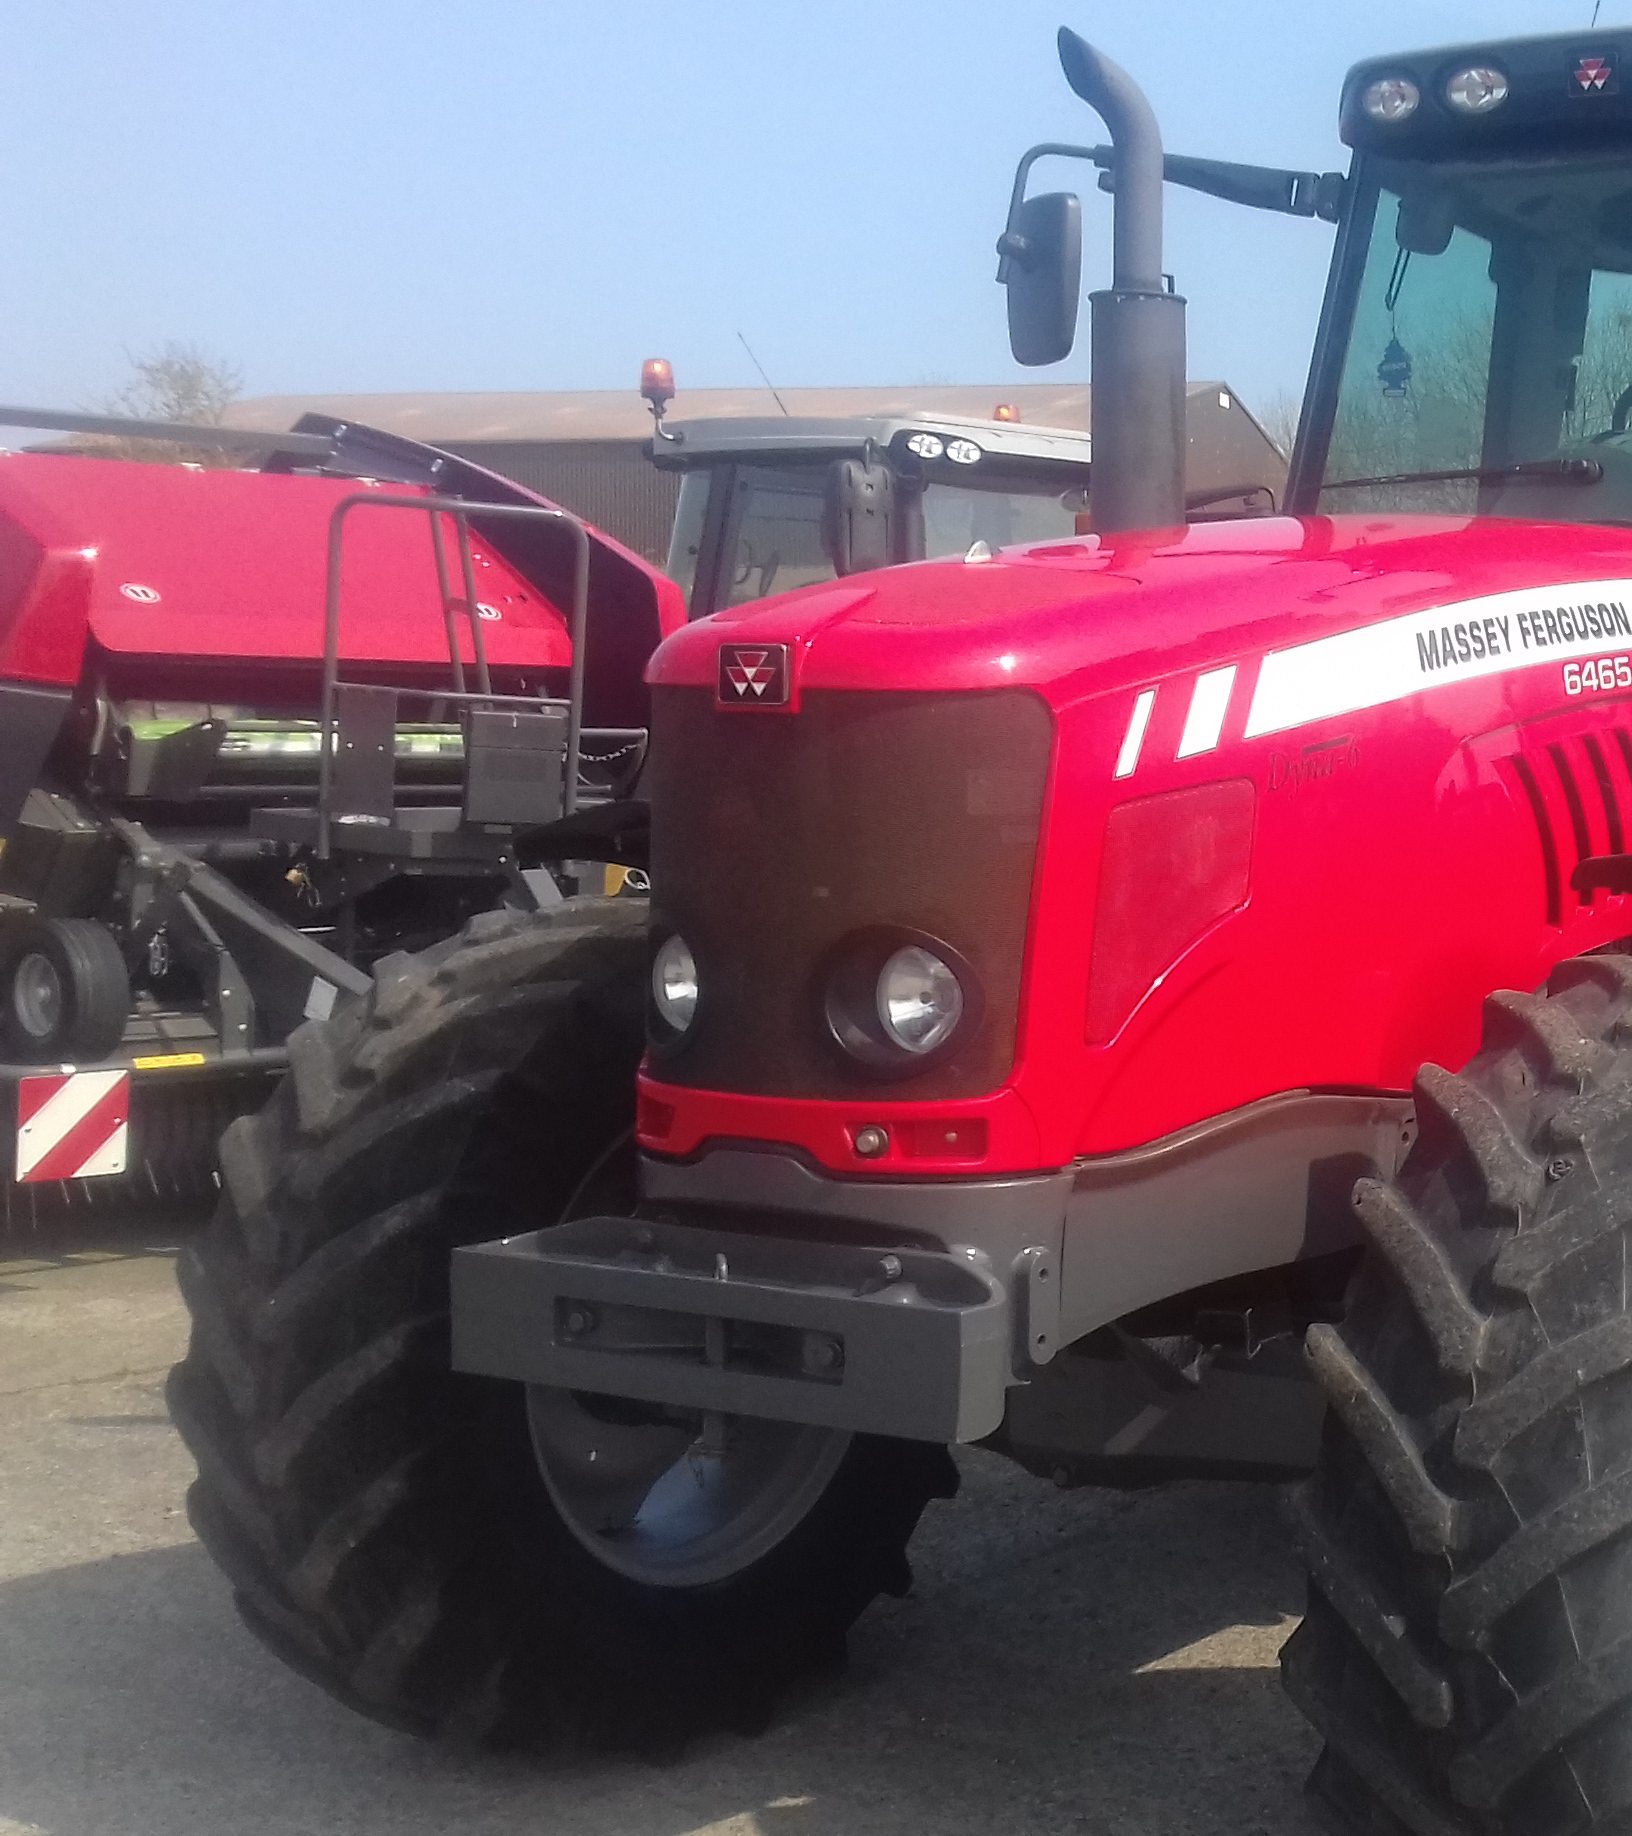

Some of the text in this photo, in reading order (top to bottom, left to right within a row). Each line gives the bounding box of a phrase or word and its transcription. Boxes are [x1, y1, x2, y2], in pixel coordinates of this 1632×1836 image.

[1416, 602, 1632, 673] MASSEY FERGUSON
[1562, 656, 1632, 696] 6465
